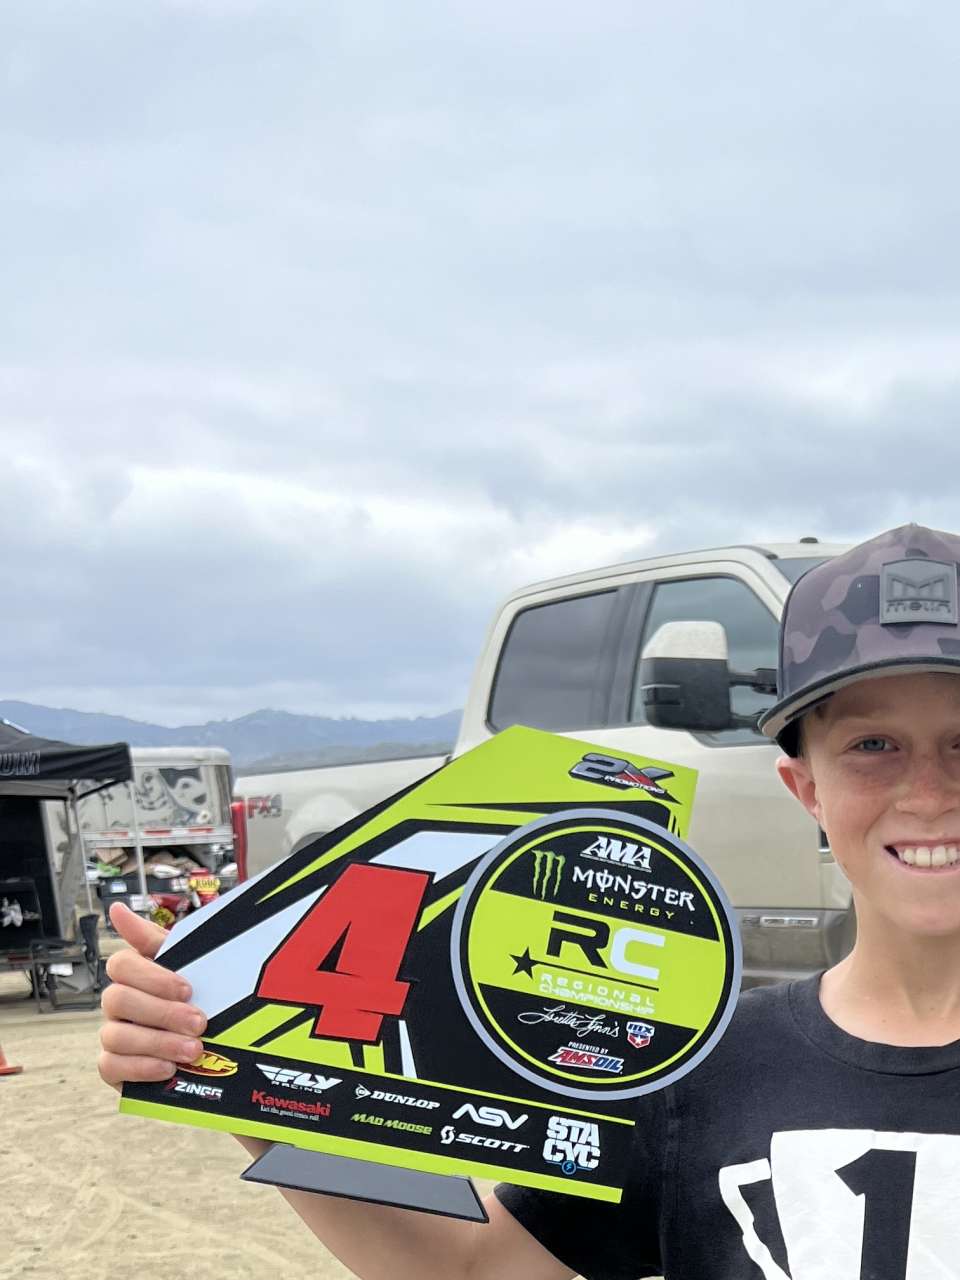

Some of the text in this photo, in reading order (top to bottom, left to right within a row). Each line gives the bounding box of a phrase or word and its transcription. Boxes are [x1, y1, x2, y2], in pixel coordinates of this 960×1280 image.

[568, 752, 682, 805] 2X
[579, 835, 652, 869] AMA
[572, 866, 696, 911] MONSTER
[589, 893, 675, 920] ENERGY
[258, 864, 436, 1043] 4
[546, 910, 660, 980] RC
[553, 1049, 623, 1072] AMSOIL
[568, 1041, 609, 1055] PRESENTED BY
[194, 1051, 239, 1073] MF
[271, 1080, 322, 1094] RACING
[370, 1090, 441, 1110] DUNLOP
[251, 1089, 331, 1117] Kawasaki
[452, 1103, 529, 1130] ASV
[350, 1113, 383, 1127] MAD
[546, 1116, 600, 1147] STA
[455, 1132, 528, 1153] SCOTT
[542, 1138, 601, 1169] CYC
